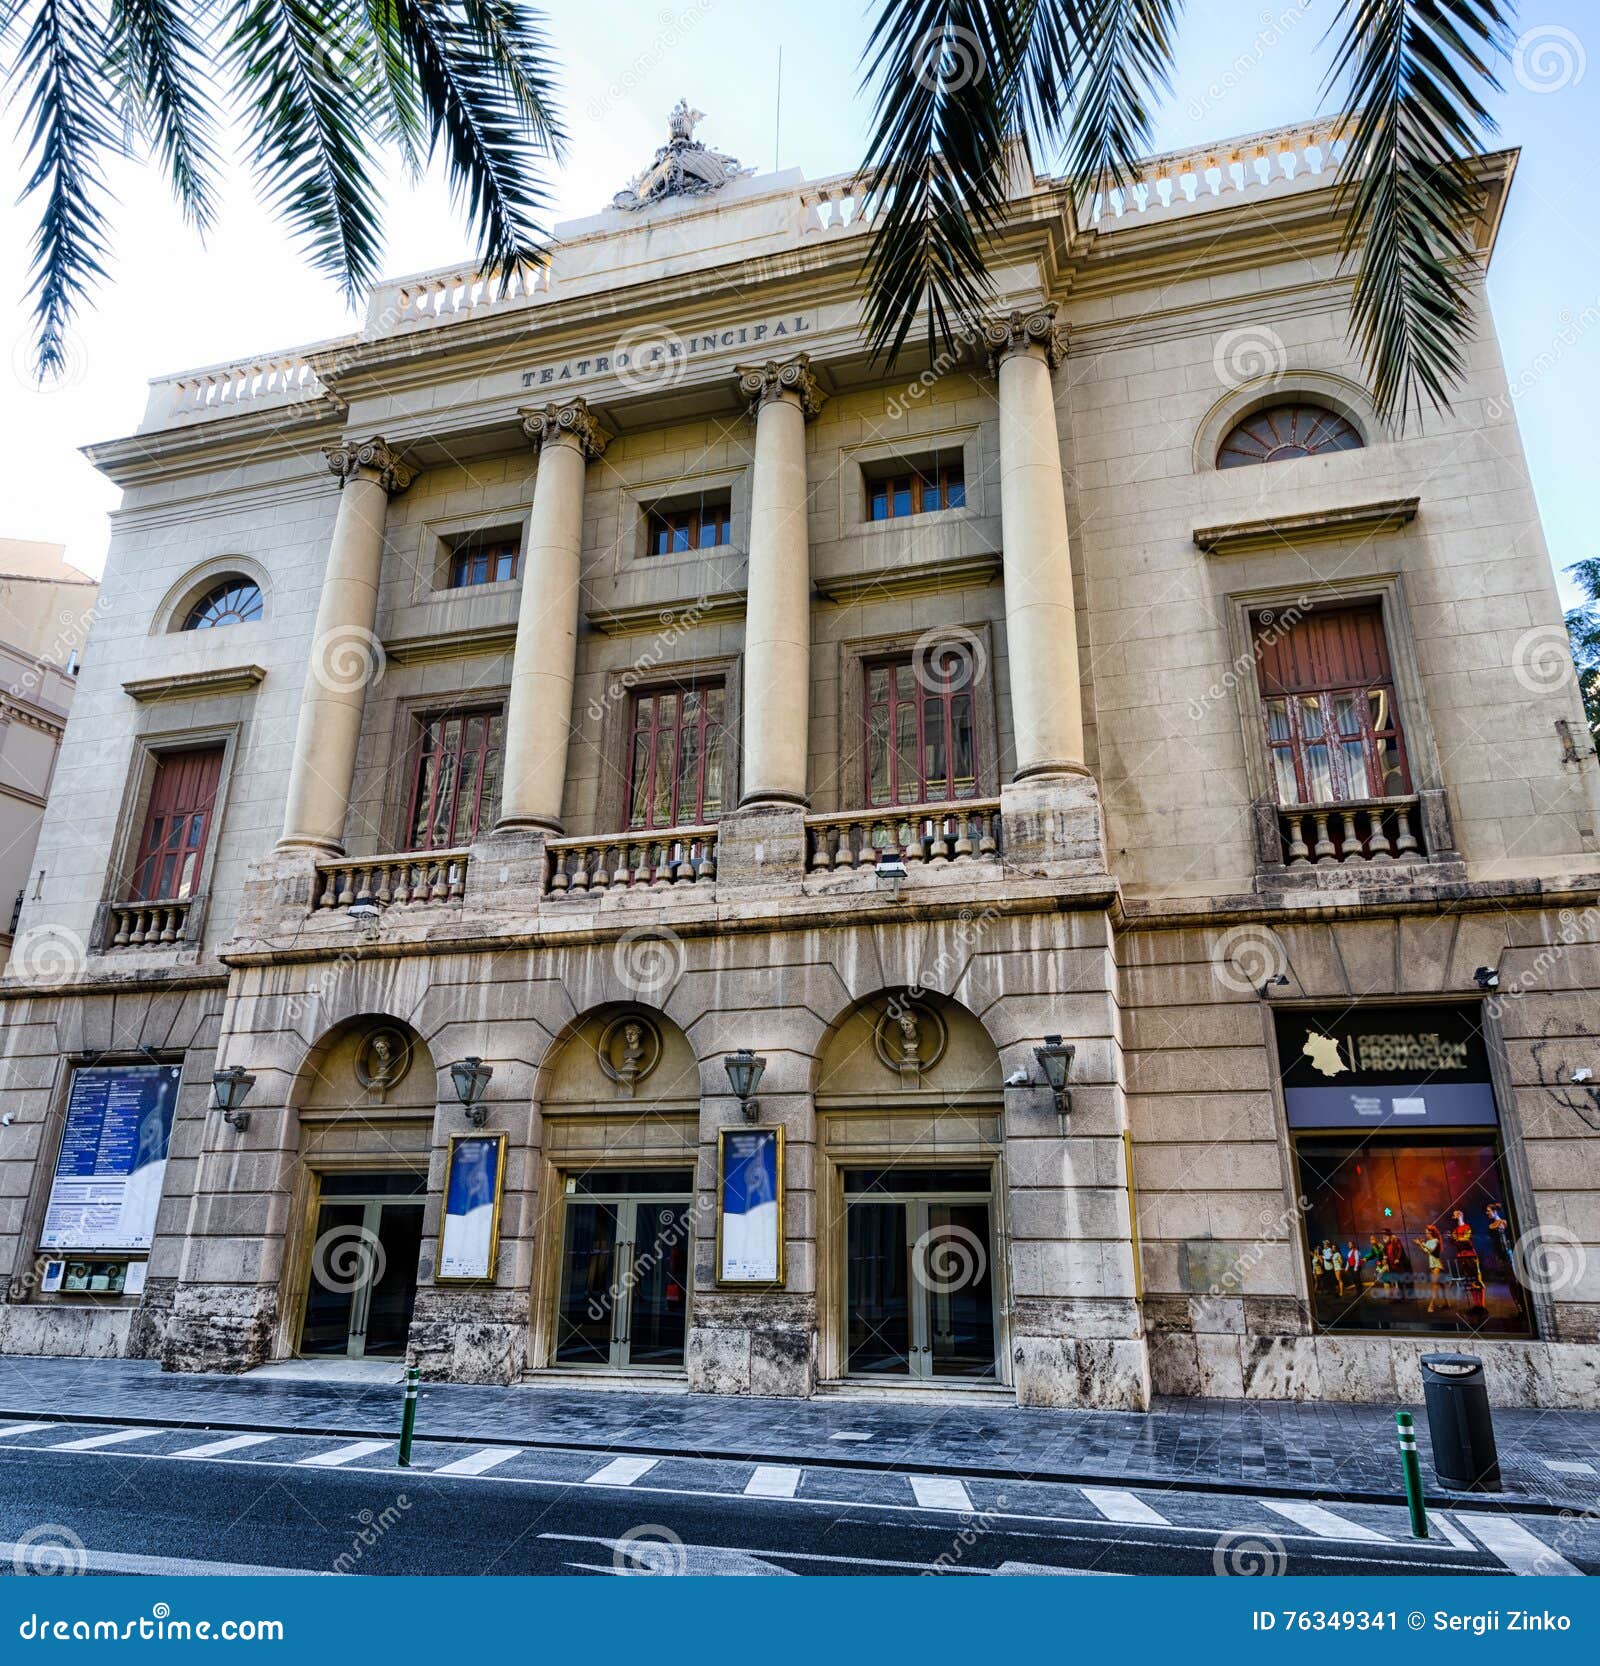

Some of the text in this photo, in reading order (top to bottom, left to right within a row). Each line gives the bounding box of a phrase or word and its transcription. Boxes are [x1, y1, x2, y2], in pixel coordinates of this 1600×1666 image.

[521, 316, 810, 388] TEATRO PRINCIPAL
[1357, 1033, 1440, 1046] OFICINA DE
[1360, 1055, 1468, 1071] PROVINCIAL
